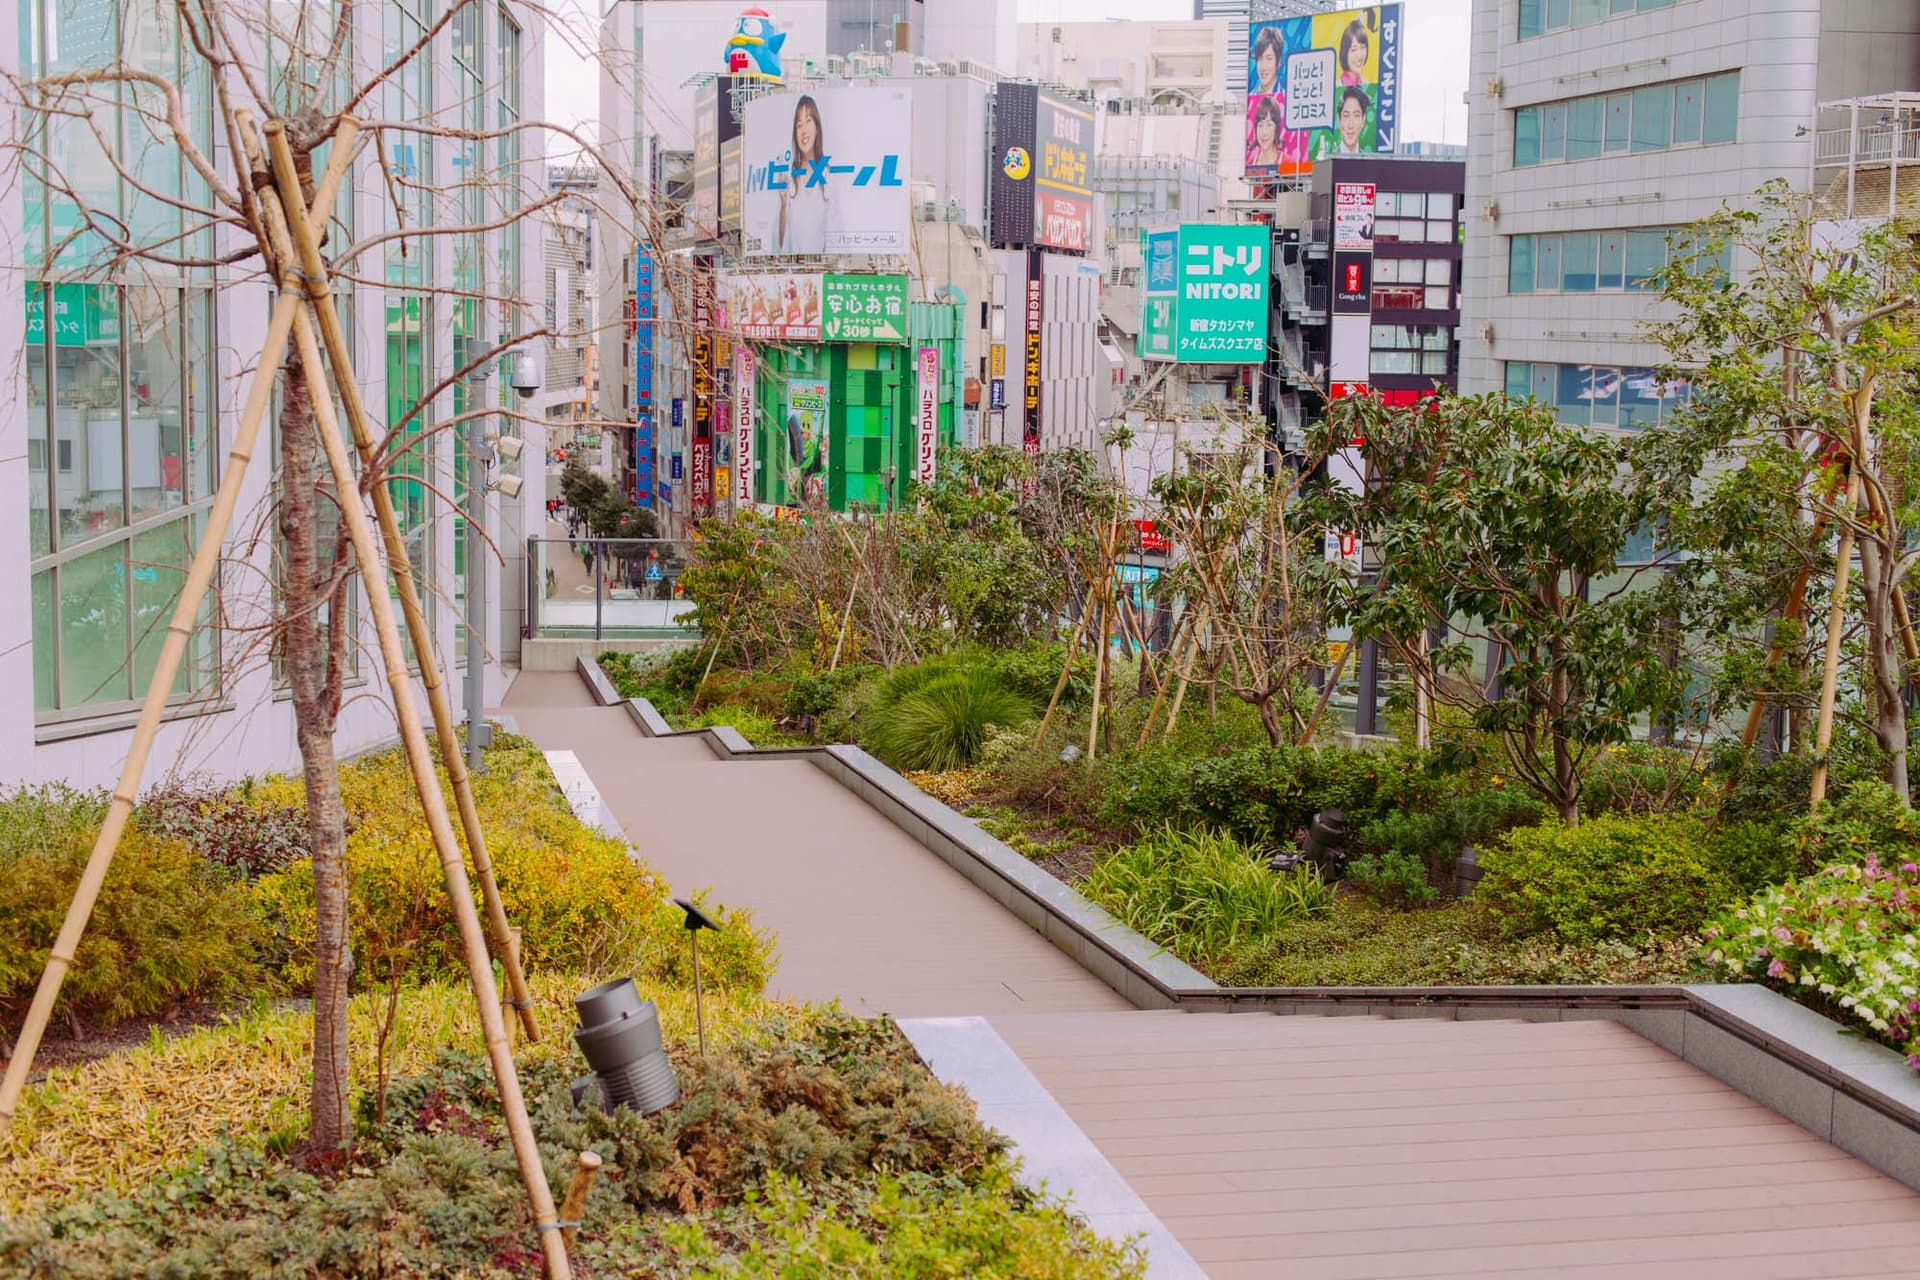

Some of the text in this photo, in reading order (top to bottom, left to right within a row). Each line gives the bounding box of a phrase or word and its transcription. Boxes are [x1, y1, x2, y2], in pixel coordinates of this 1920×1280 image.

[1294, 61, 1324, 80] パッと！
[1381, 20, 1396, 121] すぐそこ
[1293, 82, 1323, 99] ピッと！
[1293, 103, 1326, 119] プロミス
[1186, 245, 1261, 275] ニトリ
[1186, 283, 1260, 299] NITORI
[1180, 337, 1264, 350] タイムズスクエア店
